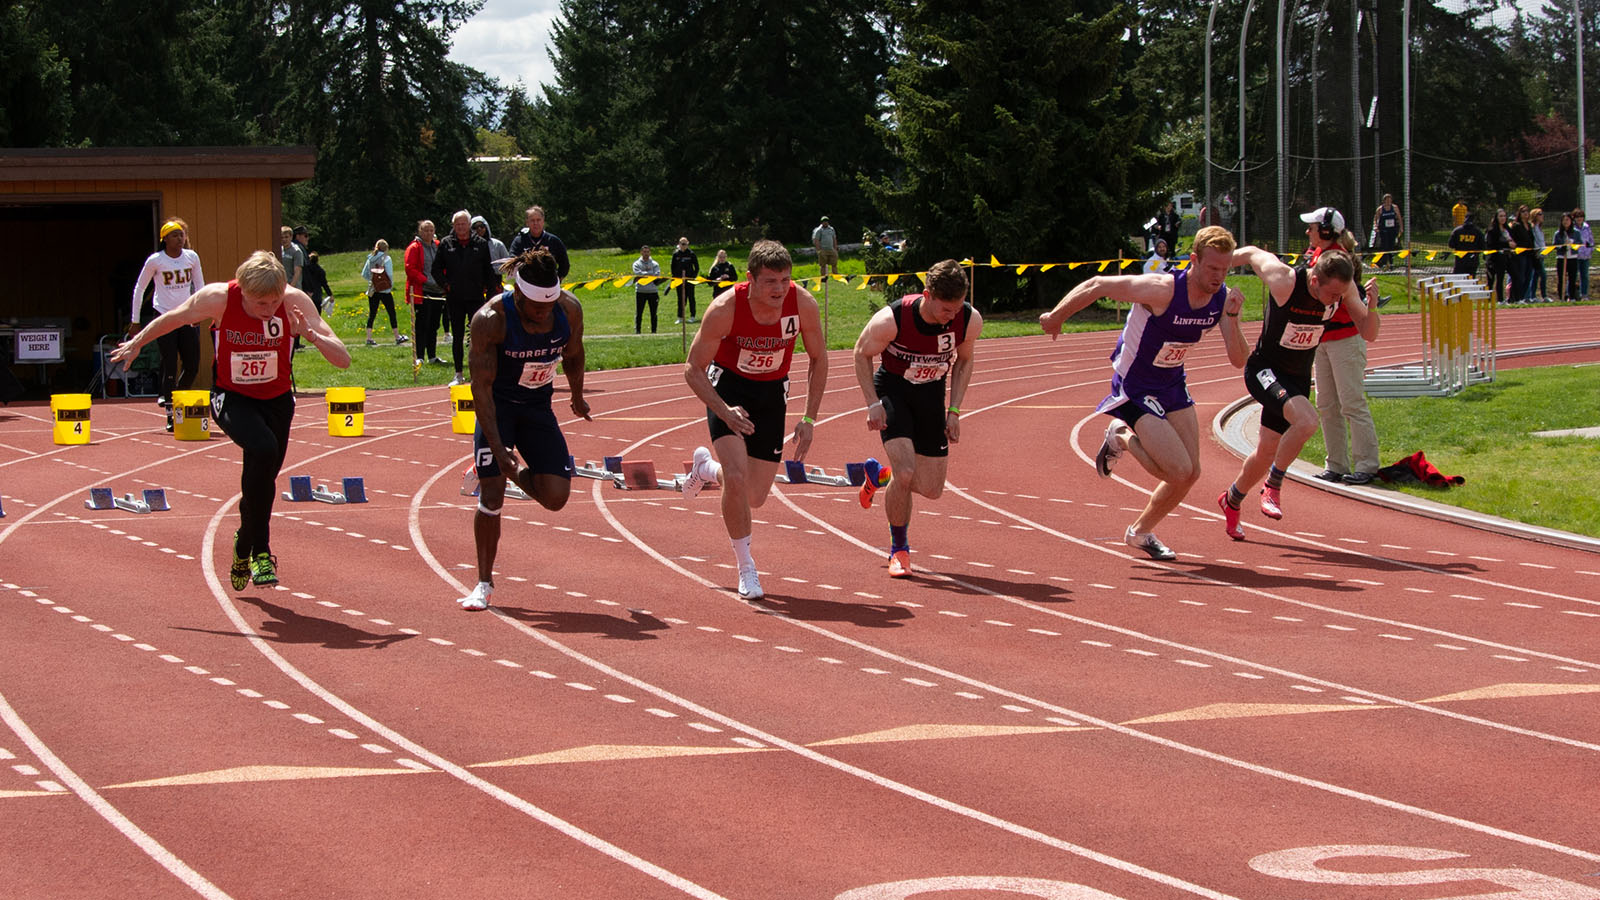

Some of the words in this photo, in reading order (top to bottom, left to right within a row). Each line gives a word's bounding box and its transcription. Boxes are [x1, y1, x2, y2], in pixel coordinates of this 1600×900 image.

[162, 268, 192, 286] PLU
[785, 316, 797, 336] 4
[1172, 314, 1214, 325] LINFIELD
[267, 316, 280, 337] 6
[20, 334, 48, 342] WEIGH
[49, 333, 58, 341] IN
[941, 334, 953, 352] 3
[1290, 331, 1313, 345] 204
[28, 343, 50, 351] HERE
[505, 348, 548, 358] GEORGE
[550, 343, 567, 355] FO
[747, 354, 774, 368] 256
[1164, 348, 1187, 361] 230
[241, 360, 268, 377] 267
[913, 367, 938, 380] 390
[202, 418, 209, 431] 3
[345, 414, 353, 427] 2
[74, 422, 82, 434] 4
